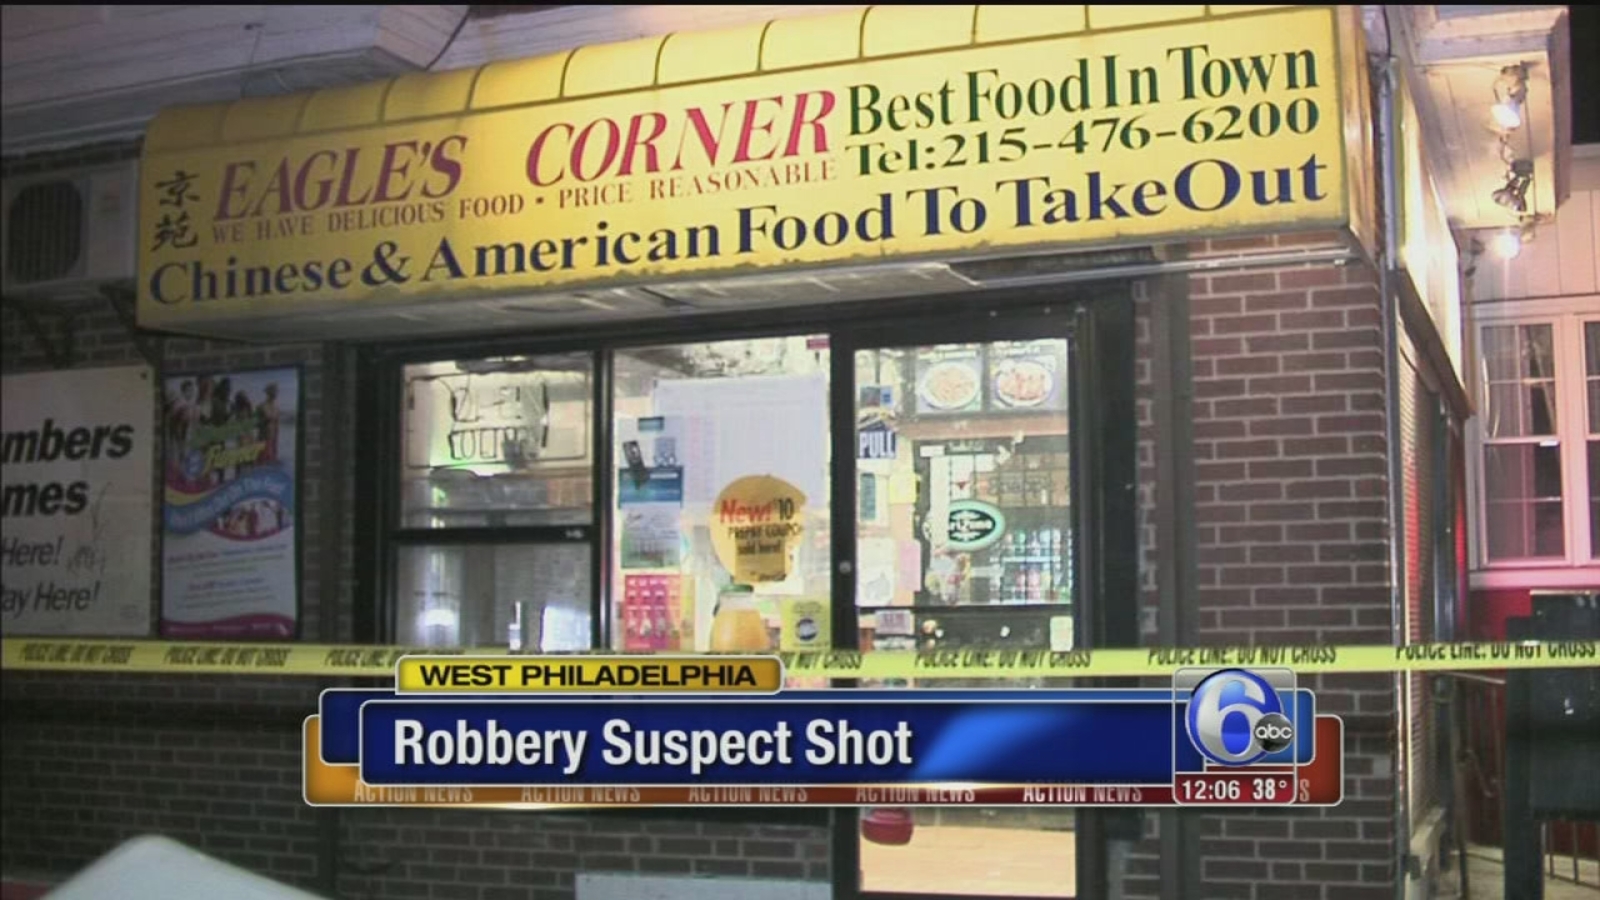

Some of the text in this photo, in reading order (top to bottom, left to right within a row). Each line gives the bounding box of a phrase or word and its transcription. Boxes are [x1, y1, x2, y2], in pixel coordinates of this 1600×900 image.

[844, 44, 1319, 136] Best Food In Town
[213, 90, 836, 221] EAGLE'S CORNER
[212, 157, 838, 244] WE HAVE DELICIOUS FOOD PRICE REASONABLE
[150, 256, 352, 305] Chinese
[360, 240, 412, 287] &
[420, 220, 721, 283] American
[735, 192, 895, 255] Food
[906, 184, 987, 237] To
[2, 418, 135, 464] mbers
[859, 430, 895, 458] PULL
[2, 479, 90, 517] mes
[33, 581, 101, 611] Here!
[1148, 646, 1194, 665] POLICE
[1237, 646, 1257, 664] DO
[1259, 645, 1287, 663] NOT
[1292, 644, 1337, 663] CROSS
